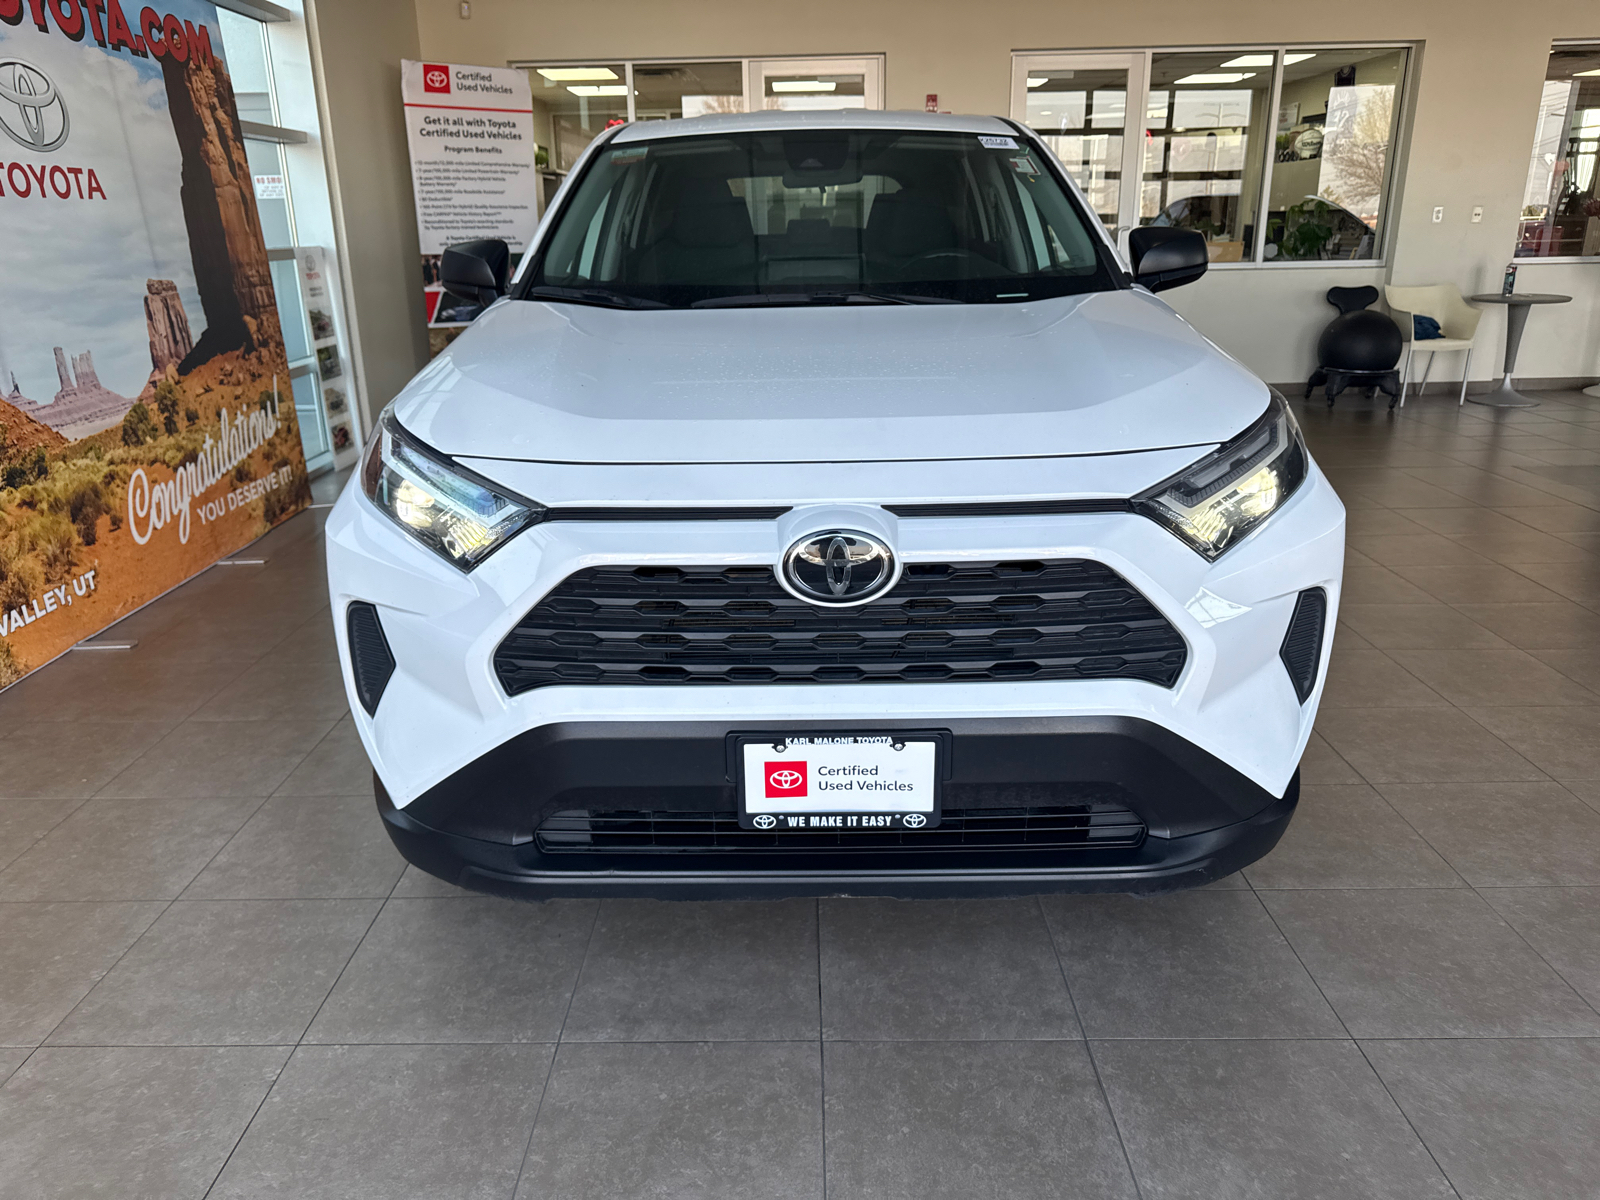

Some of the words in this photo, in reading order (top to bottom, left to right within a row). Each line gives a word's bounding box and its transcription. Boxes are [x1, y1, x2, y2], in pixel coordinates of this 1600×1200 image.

[0, 0, 215, 70] OTA.COM
[455, 71, 492, 82] Certified
[456, 83, 478, 92] Used
[480, 84, 513, 94] Vehicles
[424, 116, 442, 126] Get
[443, 117, 451, 126] it
[452, 117, 464, 126] all
[465, 118, 486, 127] with
[487, 119, 516, 130] Toyota
[420, 128, 461, 138] Certified
[462, 130, 485, 139] Used
[486, 131, 522, 140] Vehicles
[444, 146, 474, 154] Program
[475, 146, 502, 154] Benefits
[128, 373, 281, 545] Congratulations!
[197, 497, 226, 525] YOU
[227, 471, 279, 511] DESERVE
[278, 464, 294, 486] IT!
[72, 570, 95, 596] UT
[785, 737, 811, 745] KARL
[814, 737, 854, 745] MALONE
[856, 736, 893, 744] TOYOTA
[818, 765, 879, 776] Certified
[818, 780, 853, 791] Used
[856, 780, 914, 791] Vehicles
[787, 816, 805, 827] WE
[810, 816, 843, 827] MAKE
[847, 815, 858, 826] IT
[862, 815, 892, 826] EASY
